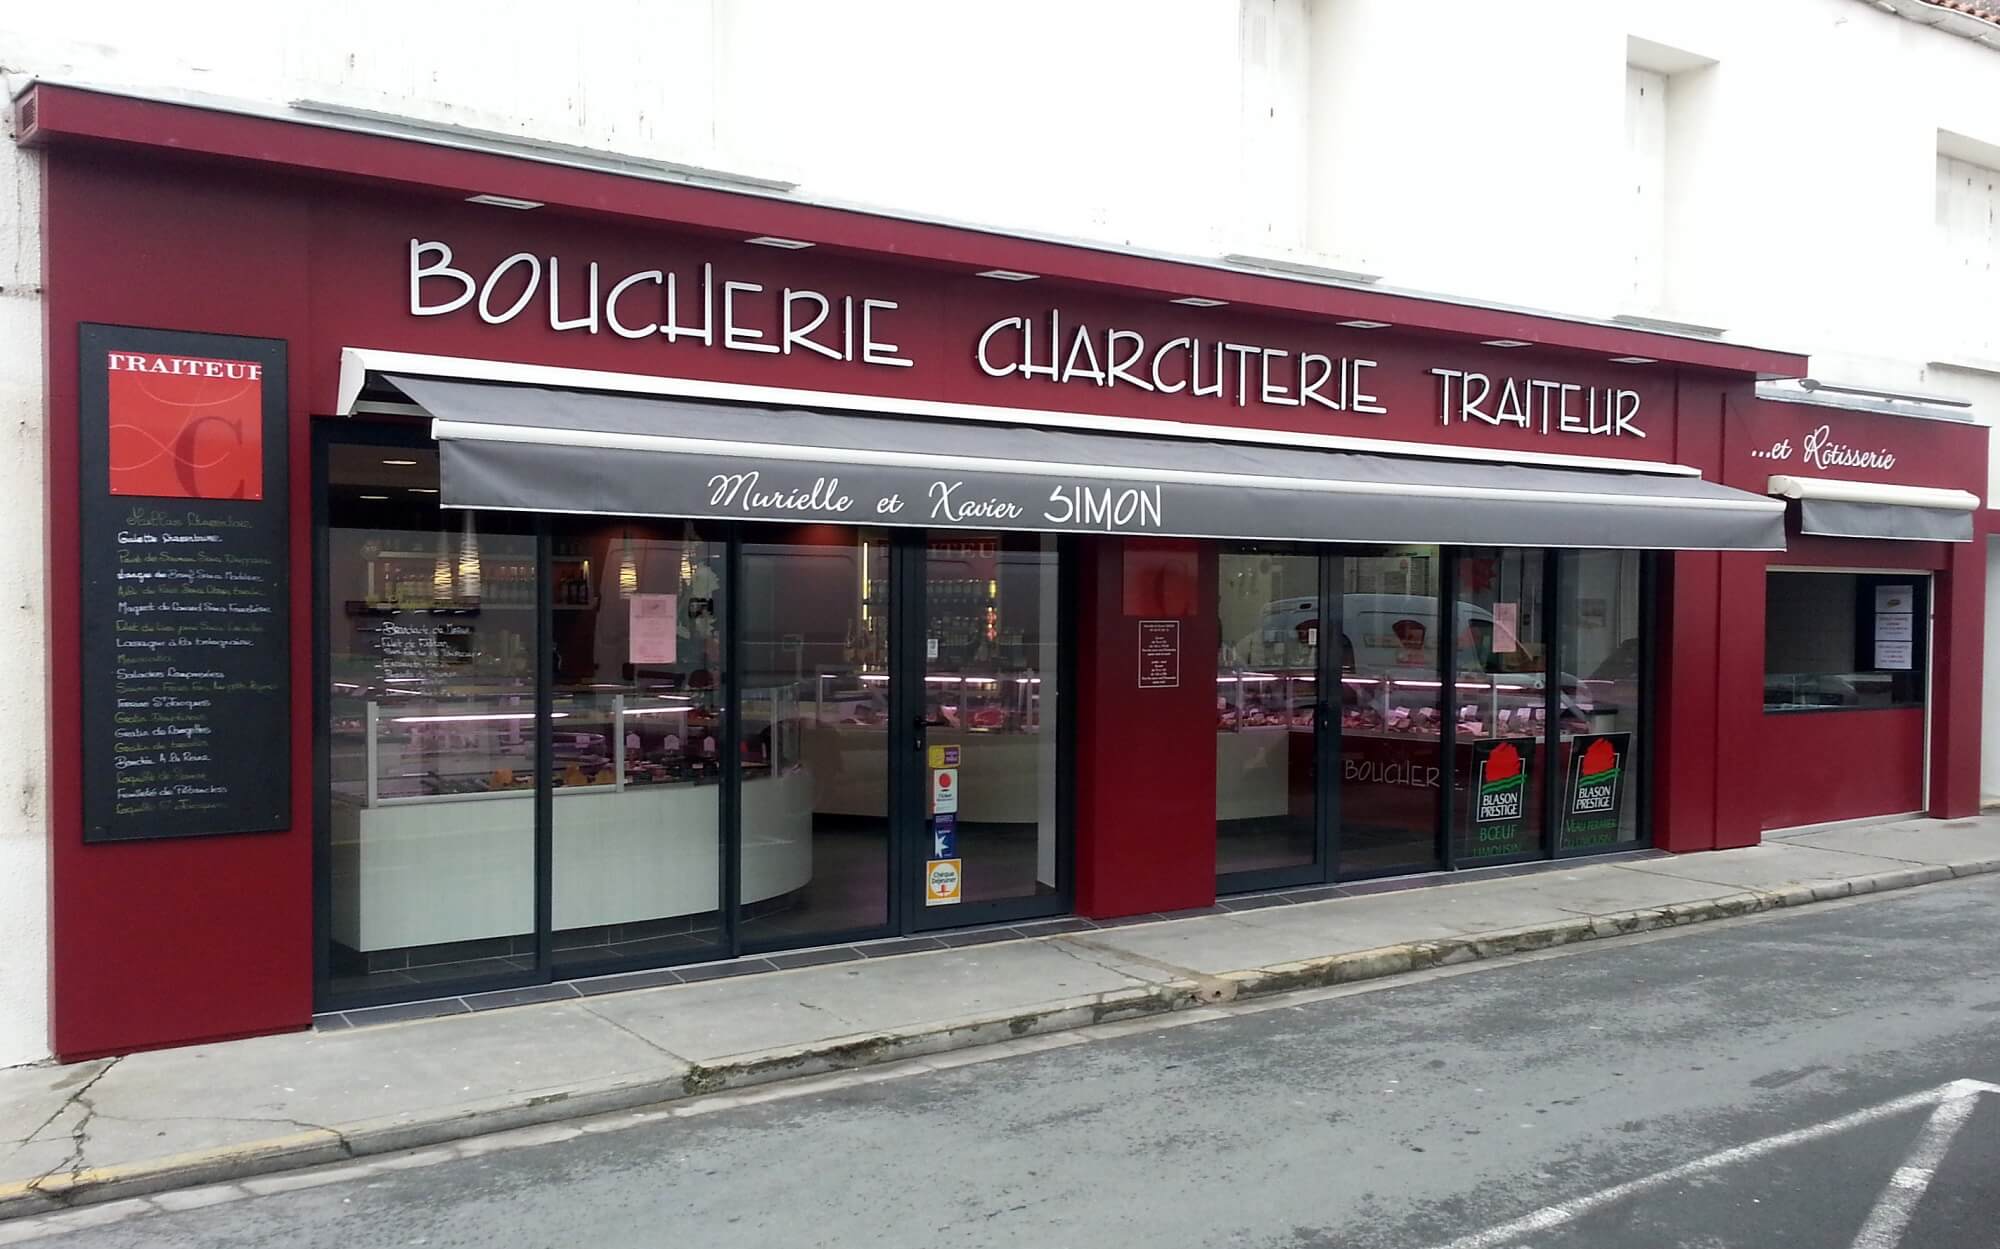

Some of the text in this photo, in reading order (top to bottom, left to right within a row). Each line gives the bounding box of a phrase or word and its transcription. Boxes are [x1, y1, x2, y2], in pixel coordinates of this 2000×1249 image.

[410, 237, 1647, 438] BOUCHERIE CHARCUTERIE TRAITEUR
[1803, 424, 1896, 470] Rôtisserie
[707, 471, 1162, 531] Murielle et Xavier SIMON
[1483, 793, 1518, 806] BLASON
[1578, 785, 1611, 799] BLASON
[1480, 803, 1518, 818] PRESTIGE
[1575, 797, 1611, 811] PRESTIGE
